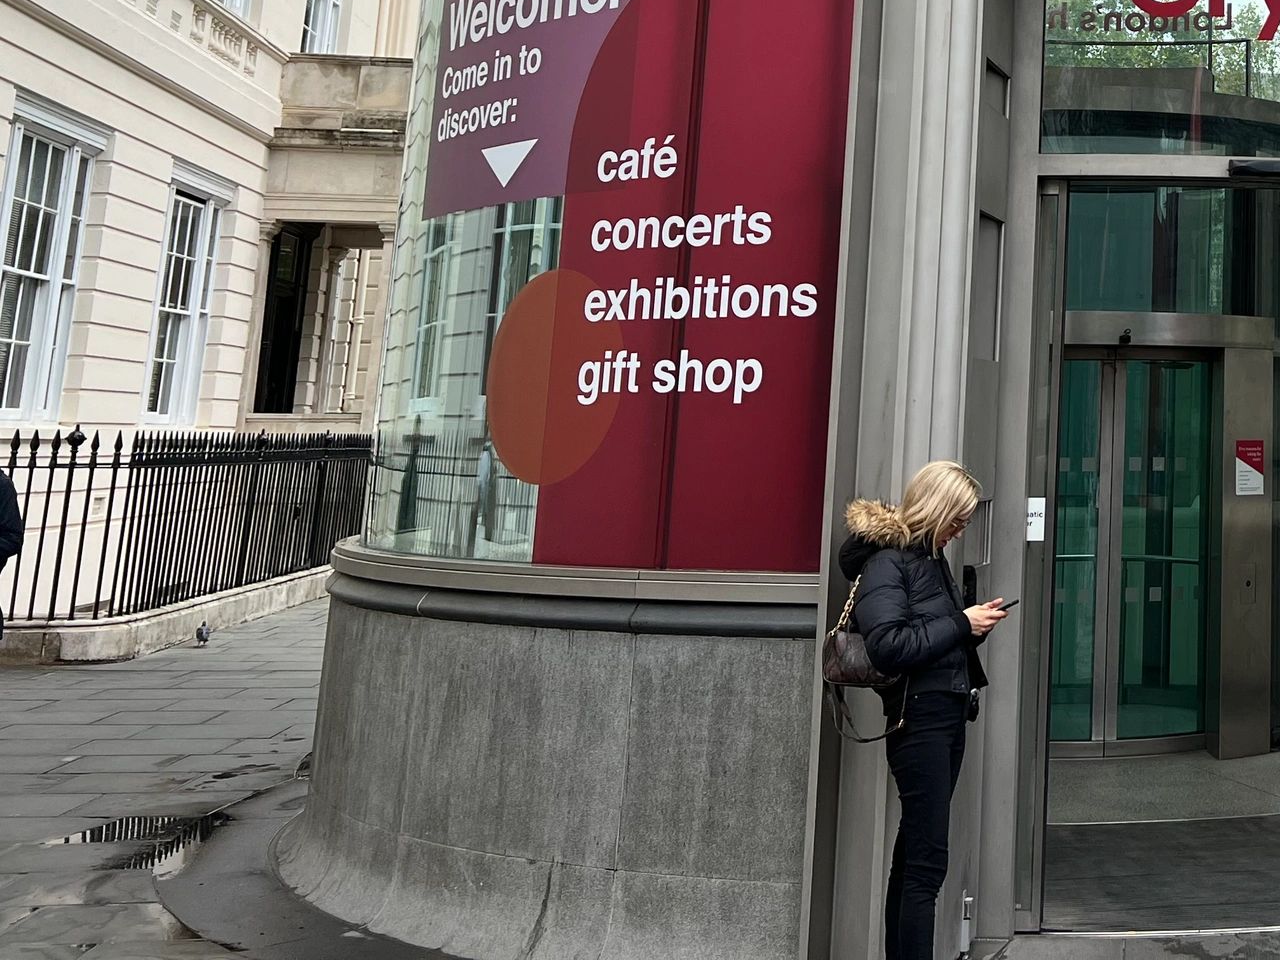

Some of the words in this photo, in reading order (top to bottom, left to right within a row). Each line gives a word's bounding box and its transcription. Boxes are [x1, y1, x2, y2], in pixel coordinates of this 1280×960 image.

[442, 62, 489, 99] Come
[493, 49, 513, 82] in
[518, 44, 543, 76] to
[437, 96, 519, 143] discover:
[596, 135, 678, 183] café
[590, 204, 773, 252] concerts
[583, 274, 819, 323] exhibitions
[576, 350, 641, 406] gift
[651, 349, 764, 405] shop
